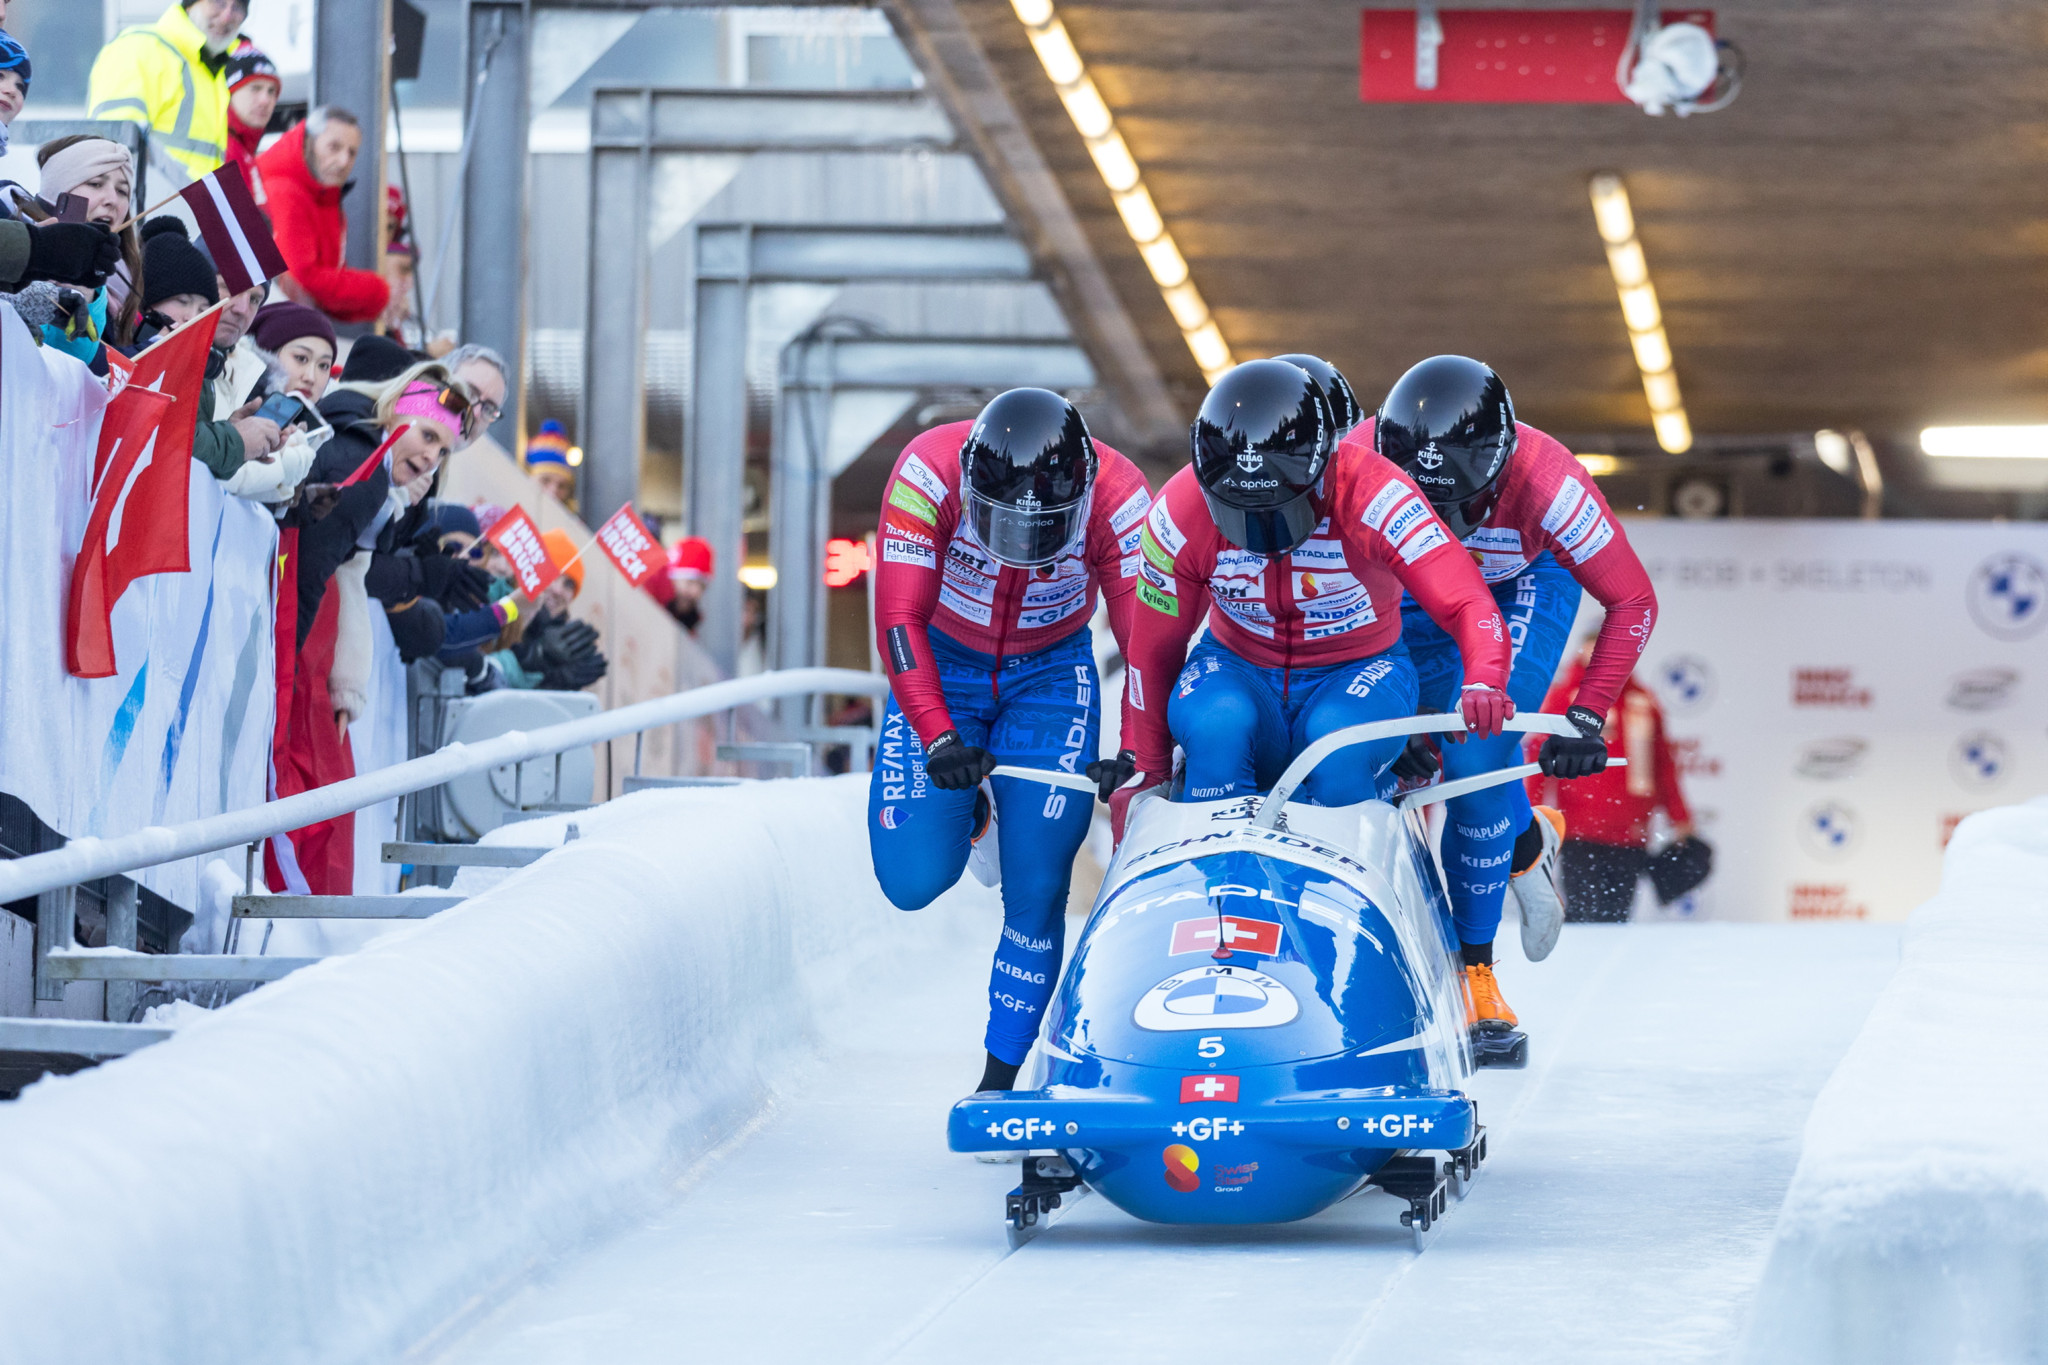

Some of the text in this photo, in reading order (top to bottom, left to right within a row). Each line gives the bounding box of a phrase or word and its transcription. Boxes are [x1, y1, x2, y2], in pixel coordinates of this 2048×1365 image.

[1308, 396, 1325, 475] STADLER
[1487, 402, 1507, 478] STADLER
[967, 423, 987, 485] STADLE
[1236, 454, 1263, 462] KIBAG
[1418, 449, 1444, 461] KIBAG
[1240, 478, 1279, 490] aprica
[1418, 474, 1456, 485] aprica
[1016, 498, 1042, 507] KIBAG
[1018, 519, 1055, 529] aprica
[1388, 503, 1424, 537] KOHLER
[1564, 503, 1595, 543] KOHLER
[885, 522, 935, 547] makita
[499, 529, 541, 593] BRUCK
[886, 540, 932, 559] HUBER
[886, 552, 921, 564] Fenster
[1292, 549, 1344, 560] STADLER
[1143, 585, 1171, 611] krieg
[1493, 612, 1504, 643] OMEGA
[1511, 574, 1537, 672] ADLER
[1637, 608, 1652, 653] OMEGA
[1571, 709, 1602, 730] HIRZL
[881, 711, 906, 801] RE/MAX
[910, 759, 928, 799] Roger
[1191, 786, 1225, 798] wams
[1456, 816, 1511, 839] SILVAPLANA
[1123, 827, 1368, 875] SCHNEIDER
[1460, 849, 1511, 869] KIBAG
[1003, 924, 1053, 951] SILVAPLANA
[995, 957, 1046, 985] KIBAG
[1197, 1036, 1226, 1059] 5
[986, 1117, 1057, 1141] +GF+
[1171, 1117, 1246, 1141] +GF+
[1363, 1114, 1434, 1138] +GF+
[1214, 1162, 1259, 1176] Swiss
